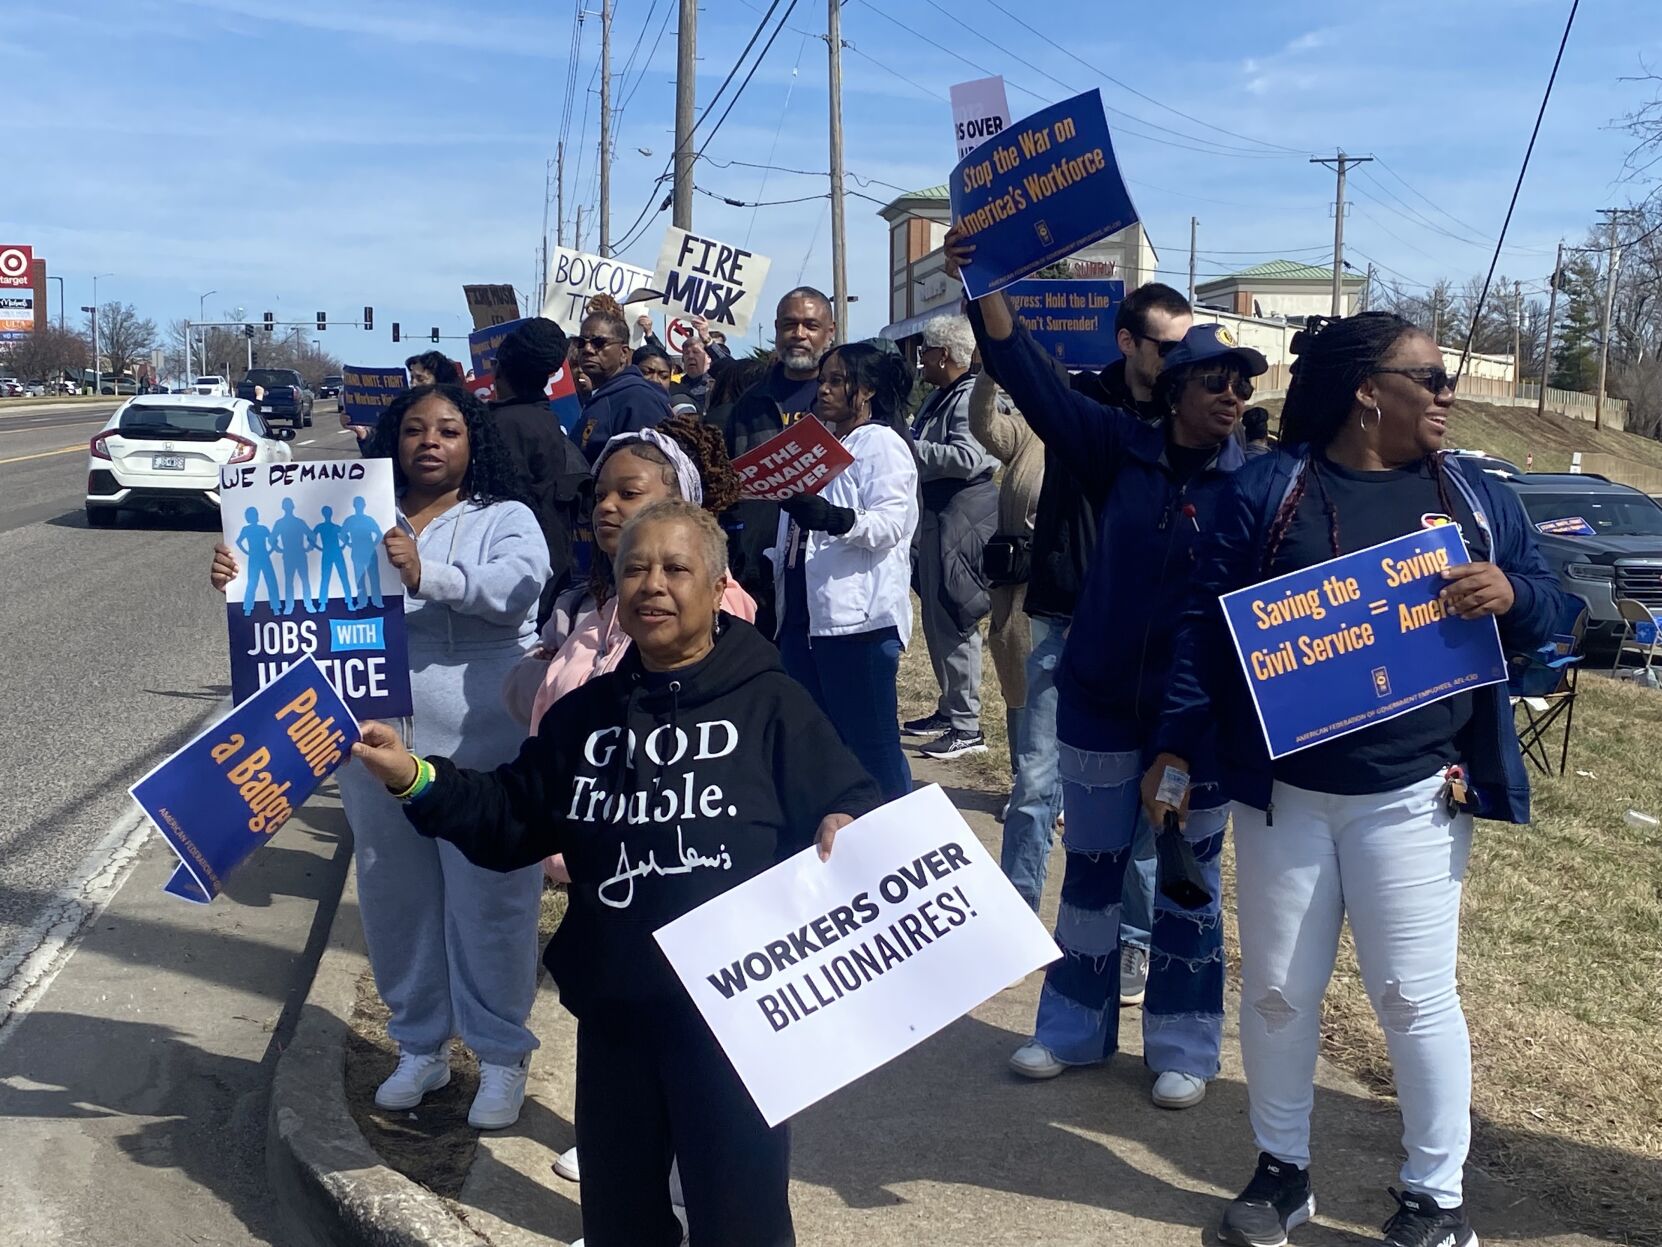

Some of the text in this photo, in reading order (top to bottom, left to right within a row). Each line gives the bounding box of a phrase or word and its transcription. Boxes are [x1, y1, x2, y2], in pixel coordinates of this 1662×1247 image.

[966, 116, 1003, 139] OVER
[963, 159, 993, 194] Stop
[993, 144, 1020, 175] the
[1018, 128, 1051, 160] War
[1054, 117, 1076, 143] on
[1023, 149, 1106, 203] Workforce
[555, 254, 654, 296] BOYCOTT
[677, 234, 752, 286] FIRE
[662, 270, 747, 325] MUSK
[1010, 295, 1043, 311] ngress:
[1045, 293, 1067, 308] Hold
[1069, 293, 1086, 308] the
[1088, 292, 1110, 308] Line
[1046, 315, 1099, 331] Surrender!
[222, 463, 365, 489] WE DEMAND
[759, 441, 802, 469] THE
[1381, 547, 1451, 588] Saving
[1252, 575, 1361, 630] Saving the
[1398, 597, 1449, 634] Amer
[247, 620, 377, 655] JOBS WITH
[1251, 622, 1375, 681] Civil Service
[275, 687, 346, 777] Public
[211, 734, 293, 834] a Badge
[706, 842, 973, 1000] WORKERS OVER
[756, 885, 978, 1032] BILLIONAIRES!
